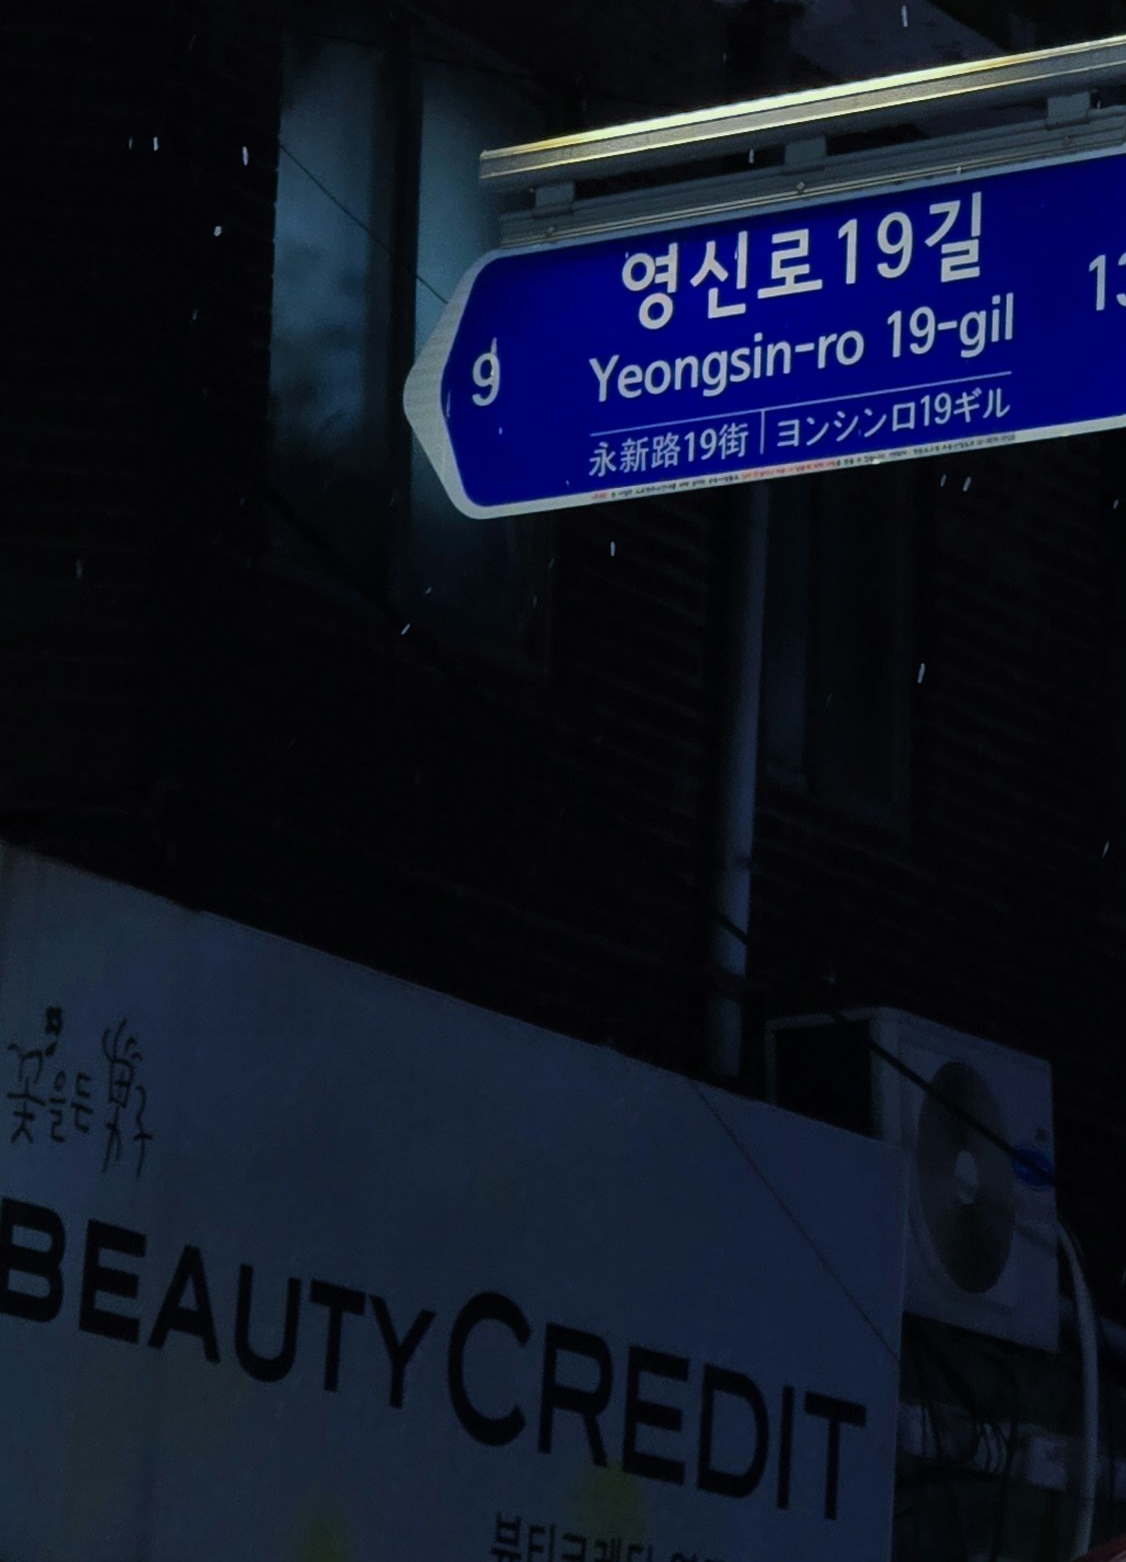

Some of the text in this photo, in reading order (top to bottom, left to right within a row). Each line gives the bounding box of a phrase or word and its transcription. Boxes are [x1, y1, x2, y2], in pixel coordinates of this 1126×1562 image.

[620, 190, 984, 331] 영신로19길
[471, 350, 501, 407] 9
[588, 291, 1015, 403] Yeongsin-ro 19-gil
[589, 420, 750, 478] 永新路19街
